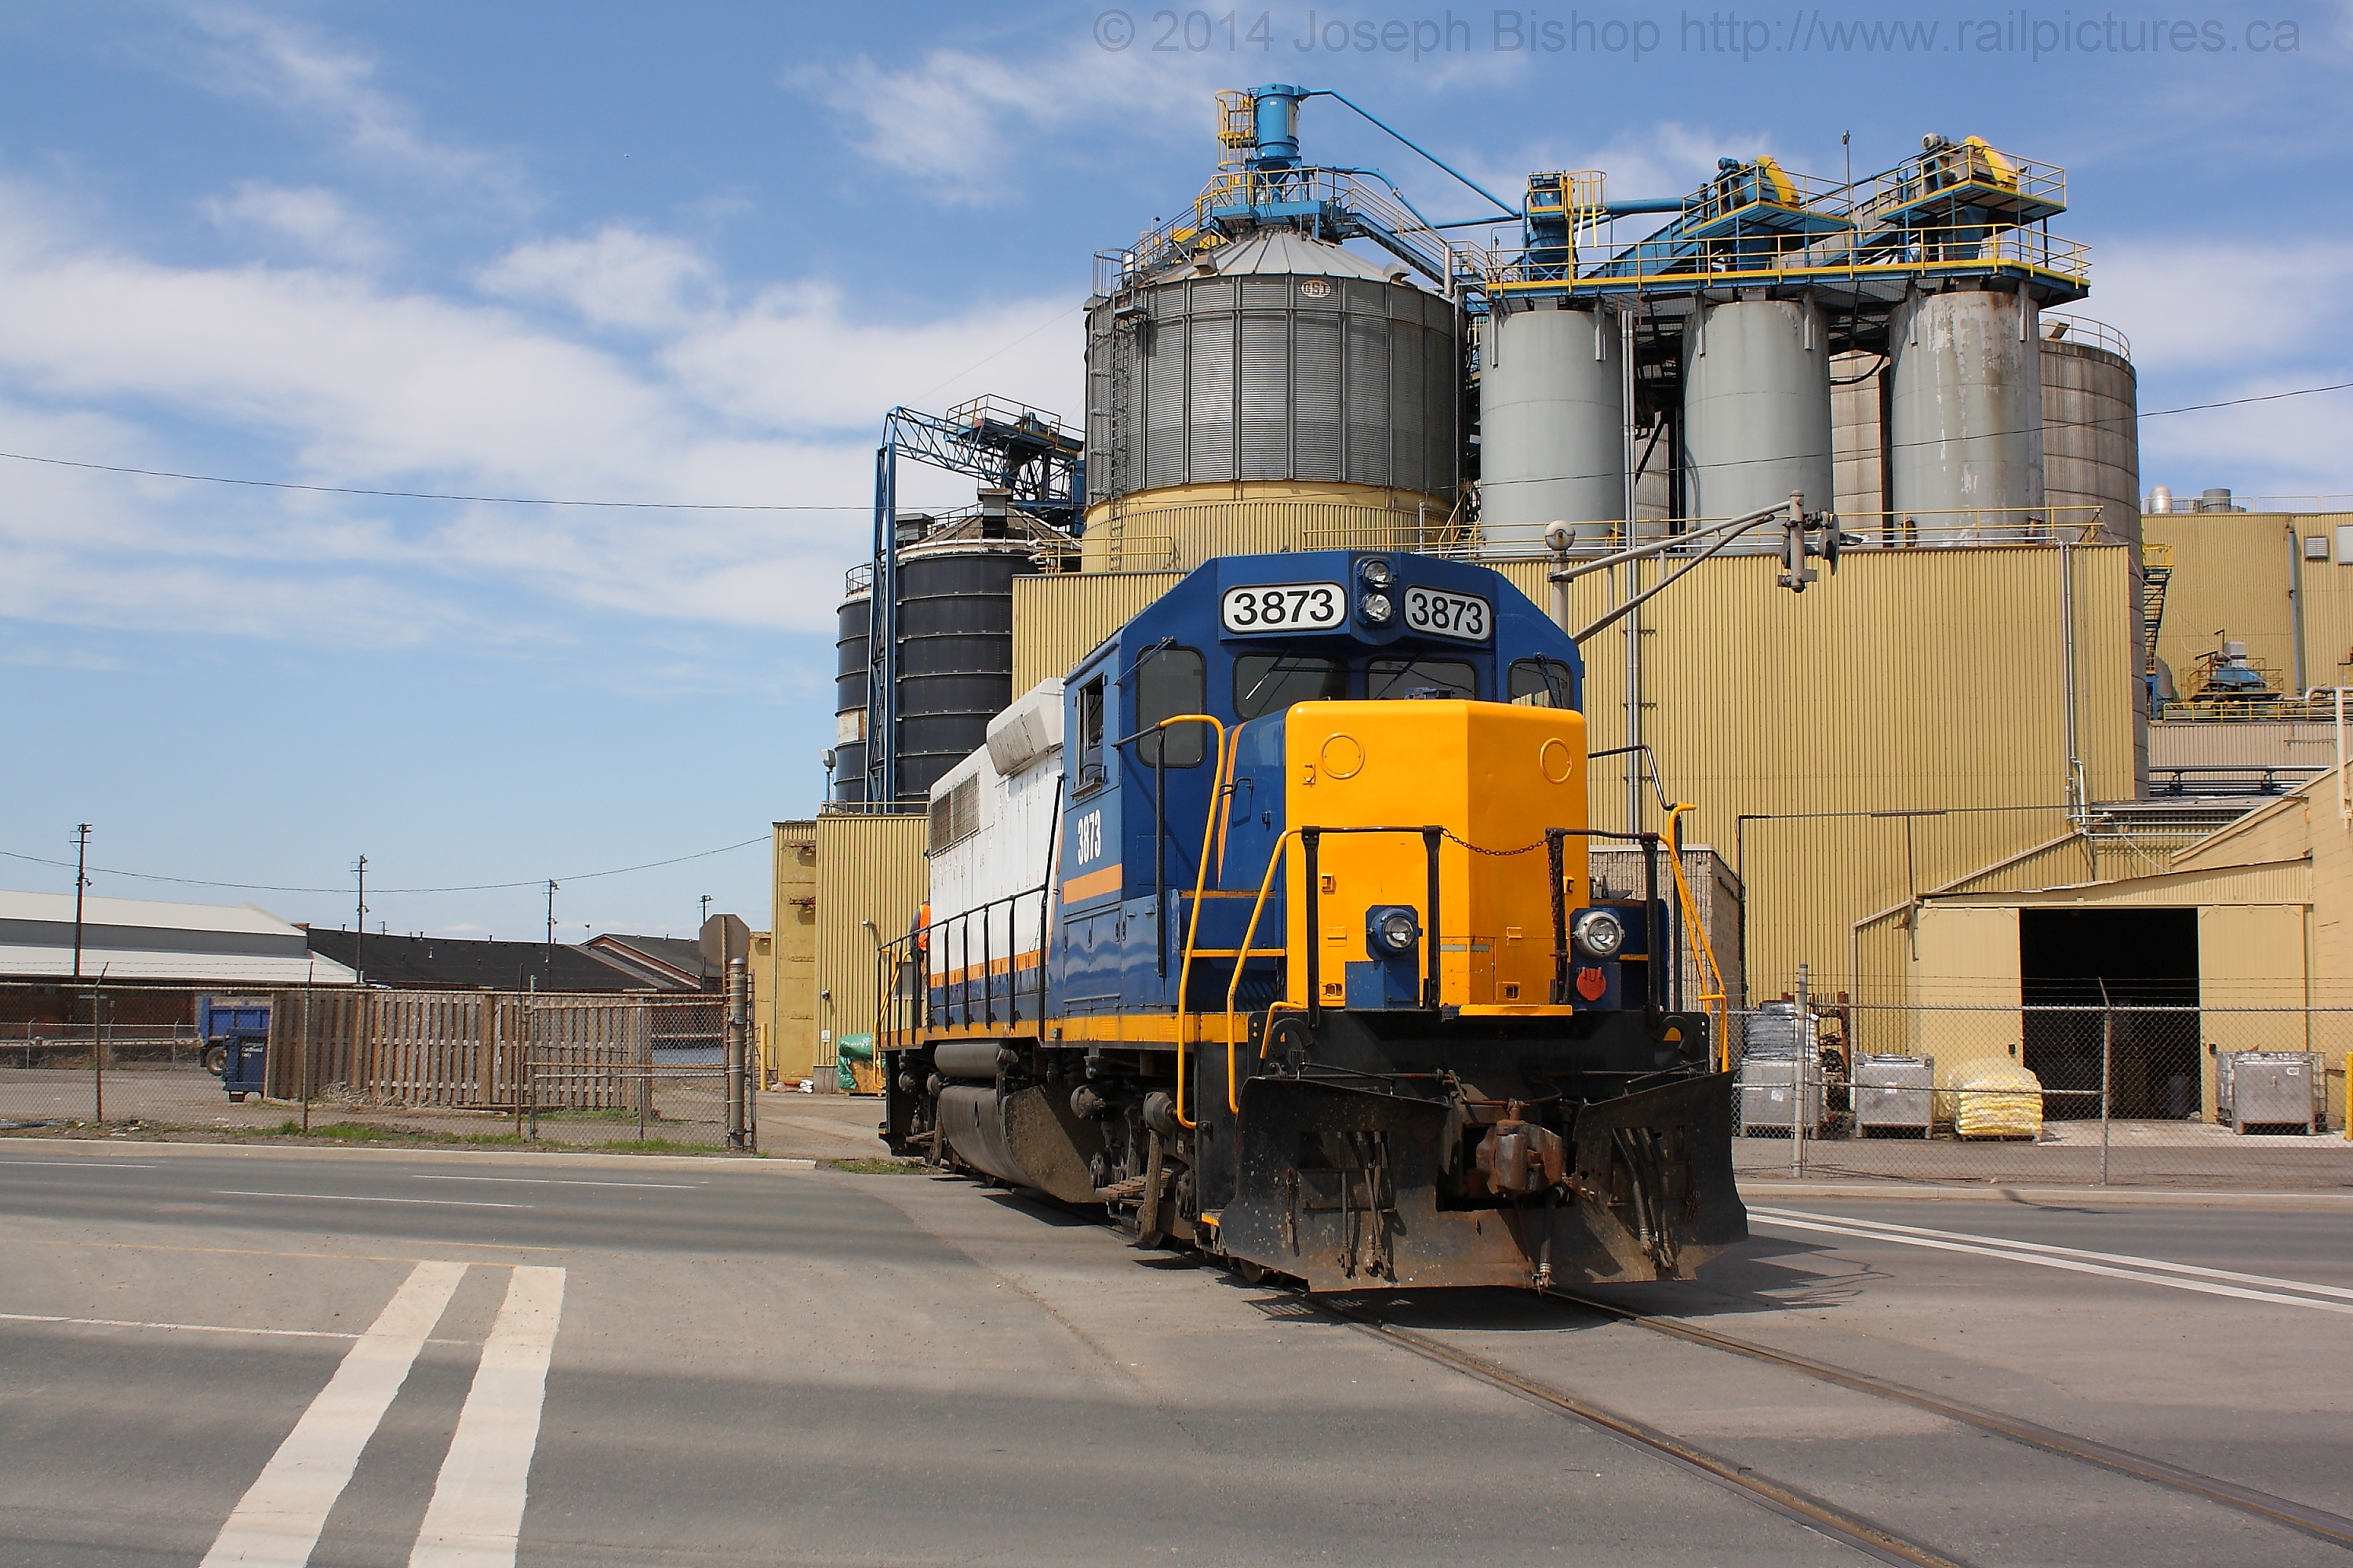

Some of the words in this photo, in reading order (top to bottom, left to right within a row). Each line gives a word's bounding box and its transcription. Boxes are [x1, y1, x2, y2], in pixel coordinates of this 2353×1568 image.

[1232, 588, 1334, 626] 3873
[1411, 592, 1483, 635] 3873
[1077, 809, 1102, 865] 3873
